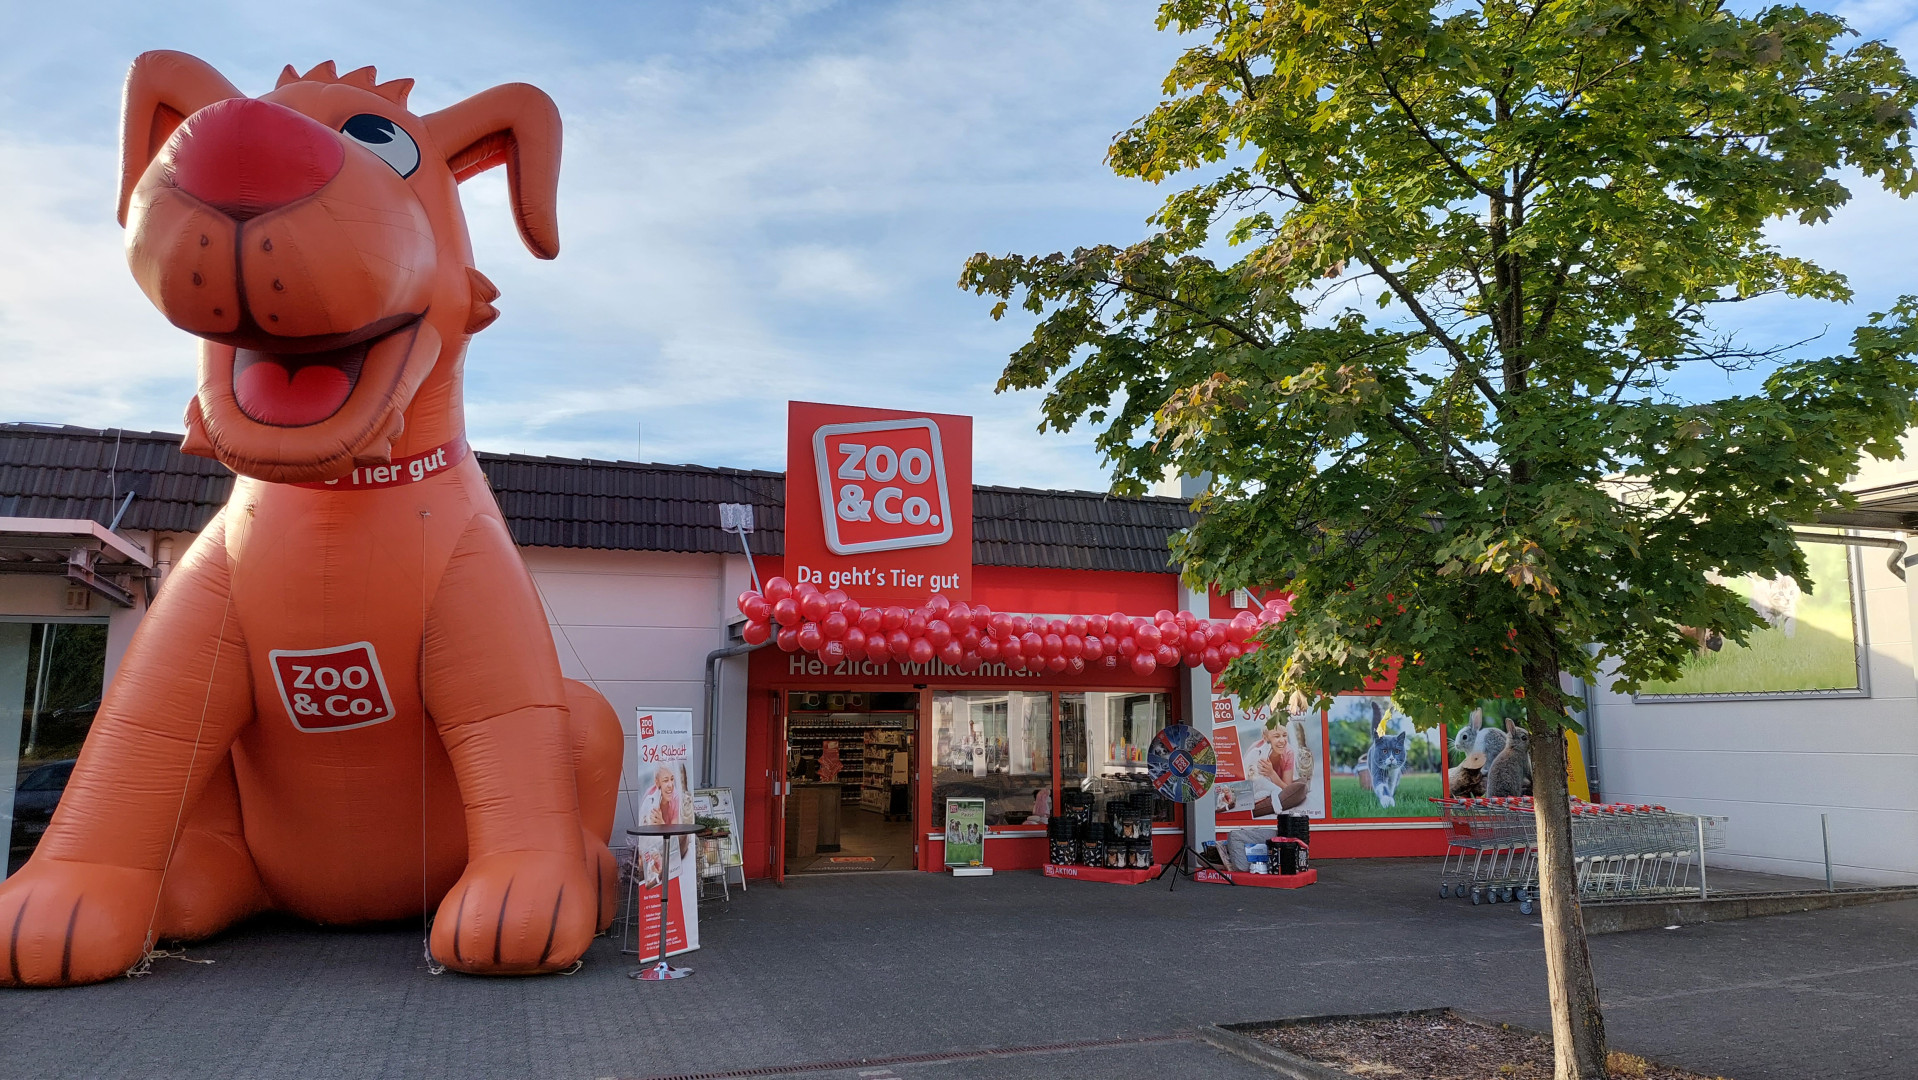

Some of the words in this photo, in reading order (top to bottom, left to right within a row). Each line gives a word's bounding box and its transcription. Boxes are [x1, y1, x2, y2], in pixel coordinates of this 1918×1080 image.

[409, 447, 447, 482] gut
[837, 443, 932, 484] ZOO
[837, 484, 940, 526] &Co.
[797, 566, 823, 584] Da
[890, 569, 925, 588] Tier
[930, 572, 960, 593] gut
[292, 665, 369, 690] ZOO
[900, 656, 1042, 677] Willkomme
[1215, 702, 1231, 711] ZOO
[641, 719, 653, 727] ZOO
[661, 744, 687, 757] Rabatt
[1055, 867, 1078, 876] AKTION
